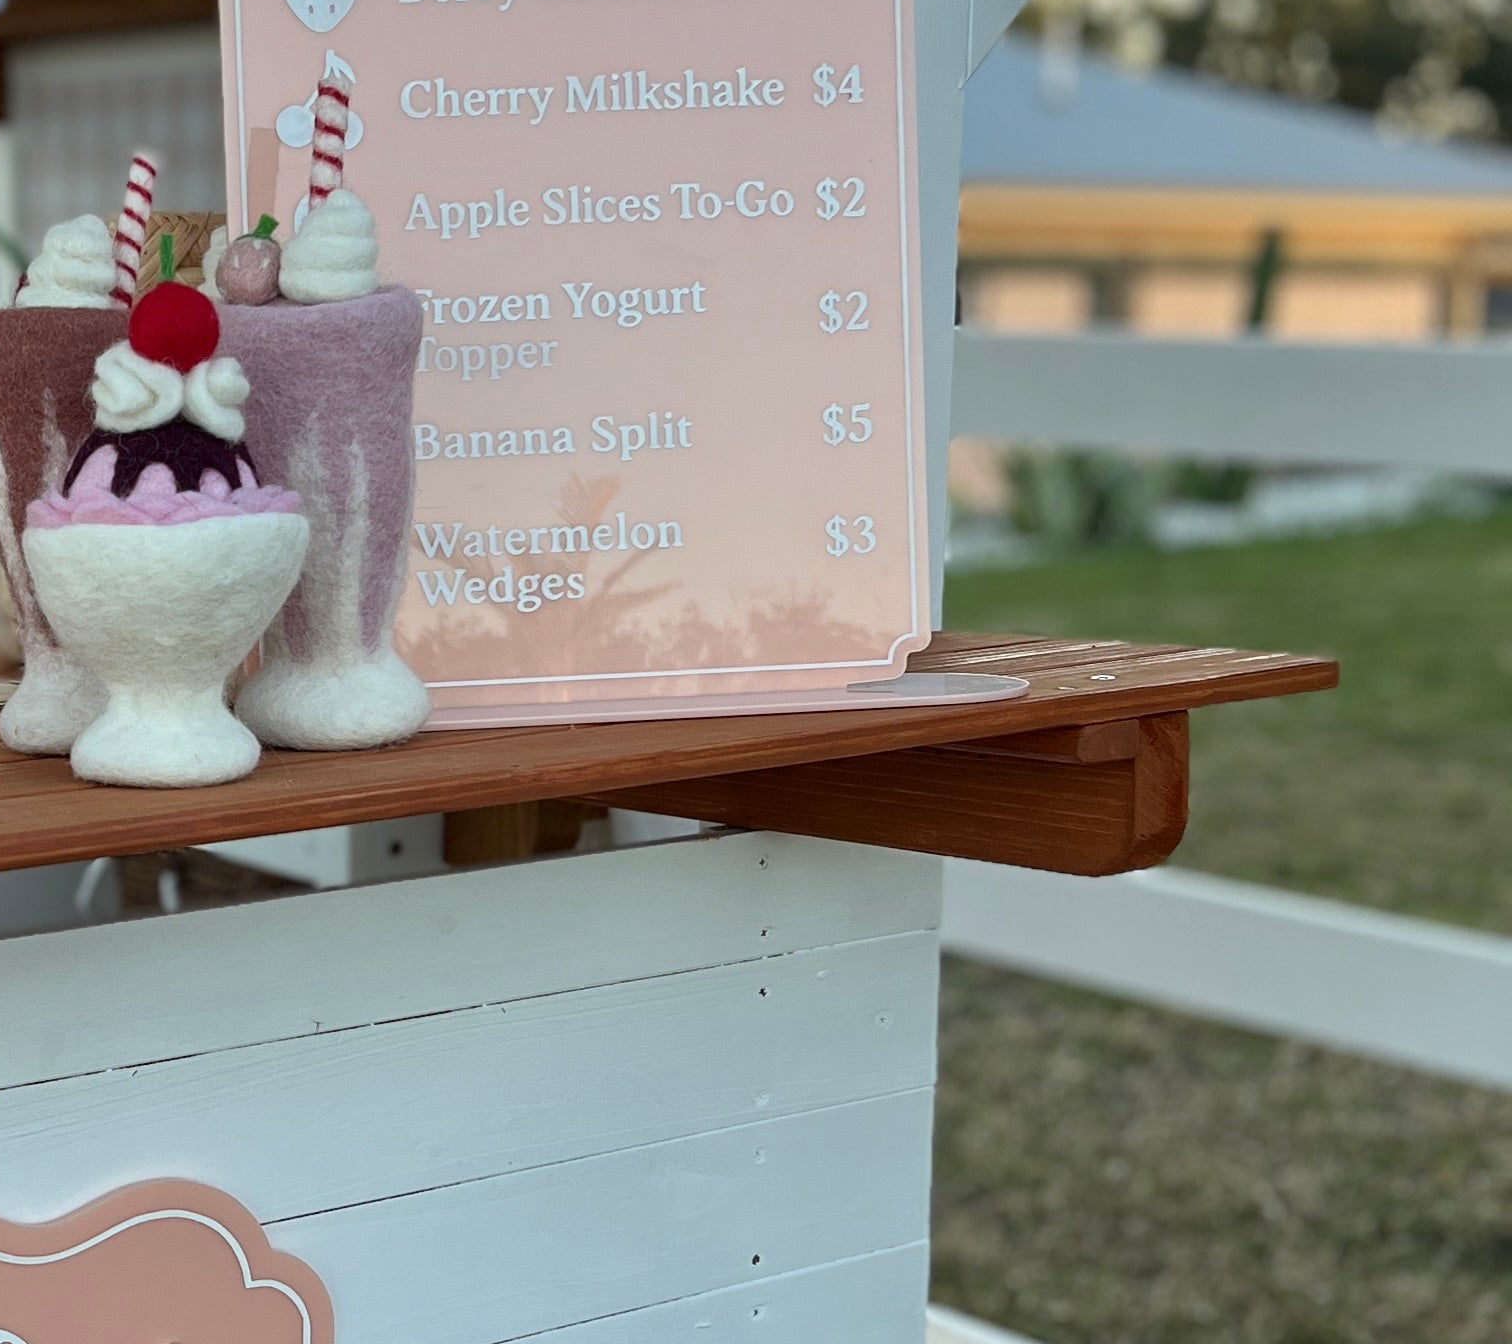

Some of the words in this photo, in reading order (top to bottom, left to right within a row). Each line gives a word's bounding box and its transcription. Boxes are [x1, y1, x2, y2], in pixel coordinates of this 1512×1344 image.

[400, 78, 553, 125] Cherry
[565, 66, 785, 113] Milkshake
[812, 62, 865, 108] $4
[405, 188, 530, 240] Apple
[542, 185, 661, 225] Slices
[670, 180, 794, 220] To-Go
[815, 176, 867, 221] $2
[561, 281, 706, 328] Yogurt
[818, 289, 870, 334] $2
[416, 336, 559, 381] Topper
[412, 423, 576, 460] Banana
[590, 411, 694, 462] Split
[821, 402, 873, 446] $5
[414, 512, 684, 559] Watermelon
[824, 514, 877, 558] $3
[416, 565, 585, 613] Wedges
